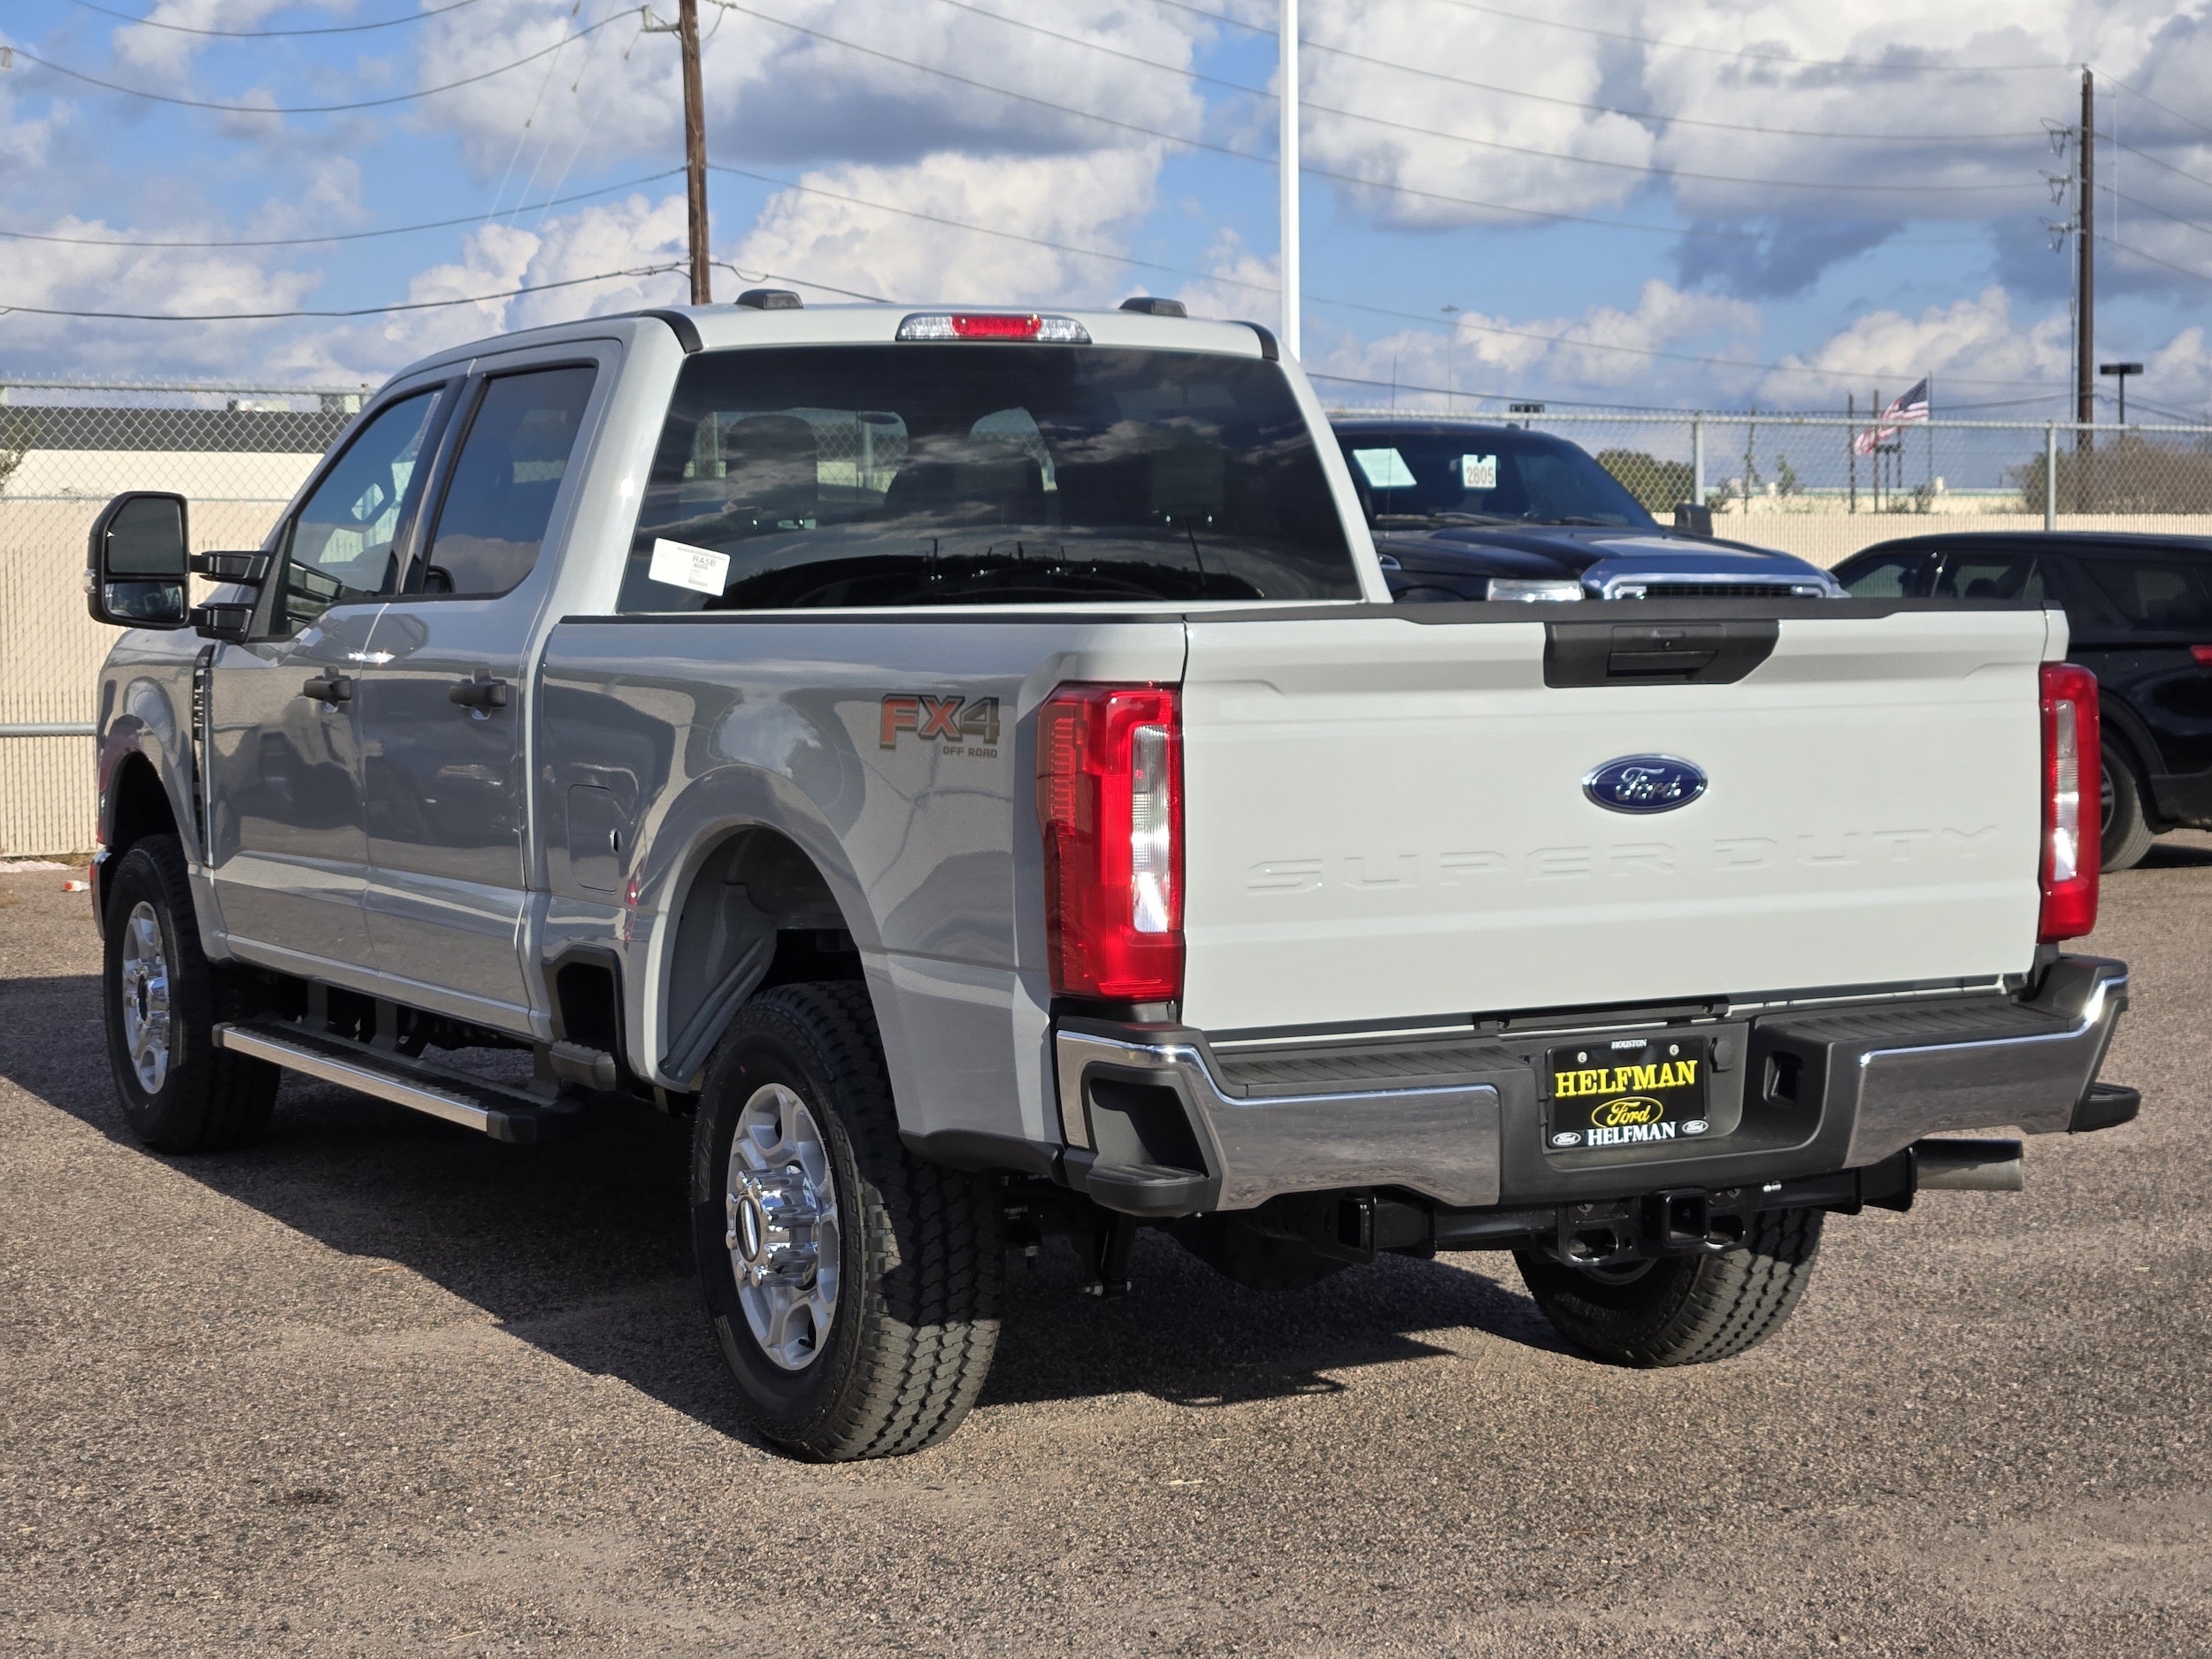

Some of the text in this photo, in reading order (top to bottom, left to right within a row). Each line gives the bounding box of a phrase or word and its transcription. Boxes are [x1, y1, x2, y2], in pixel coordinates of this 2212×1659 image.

[1466, 465, 1494, 485] 2805
[880, 694, 1001, 749] FX4
[942, 745, 998, 758] OFF ROAD
[1615, 766, 1682, 801] Ford
[1246, 825, 1997, 896] SUPER DUTY
[1611, 1039, 1647, 1049] HOUSTON
[1555, 1060, 1698, 1097] HELFMAN
[1606, 1101, 1652, 1125] Ford
[1586, 1121, 1678, 1146] HELFMAN
